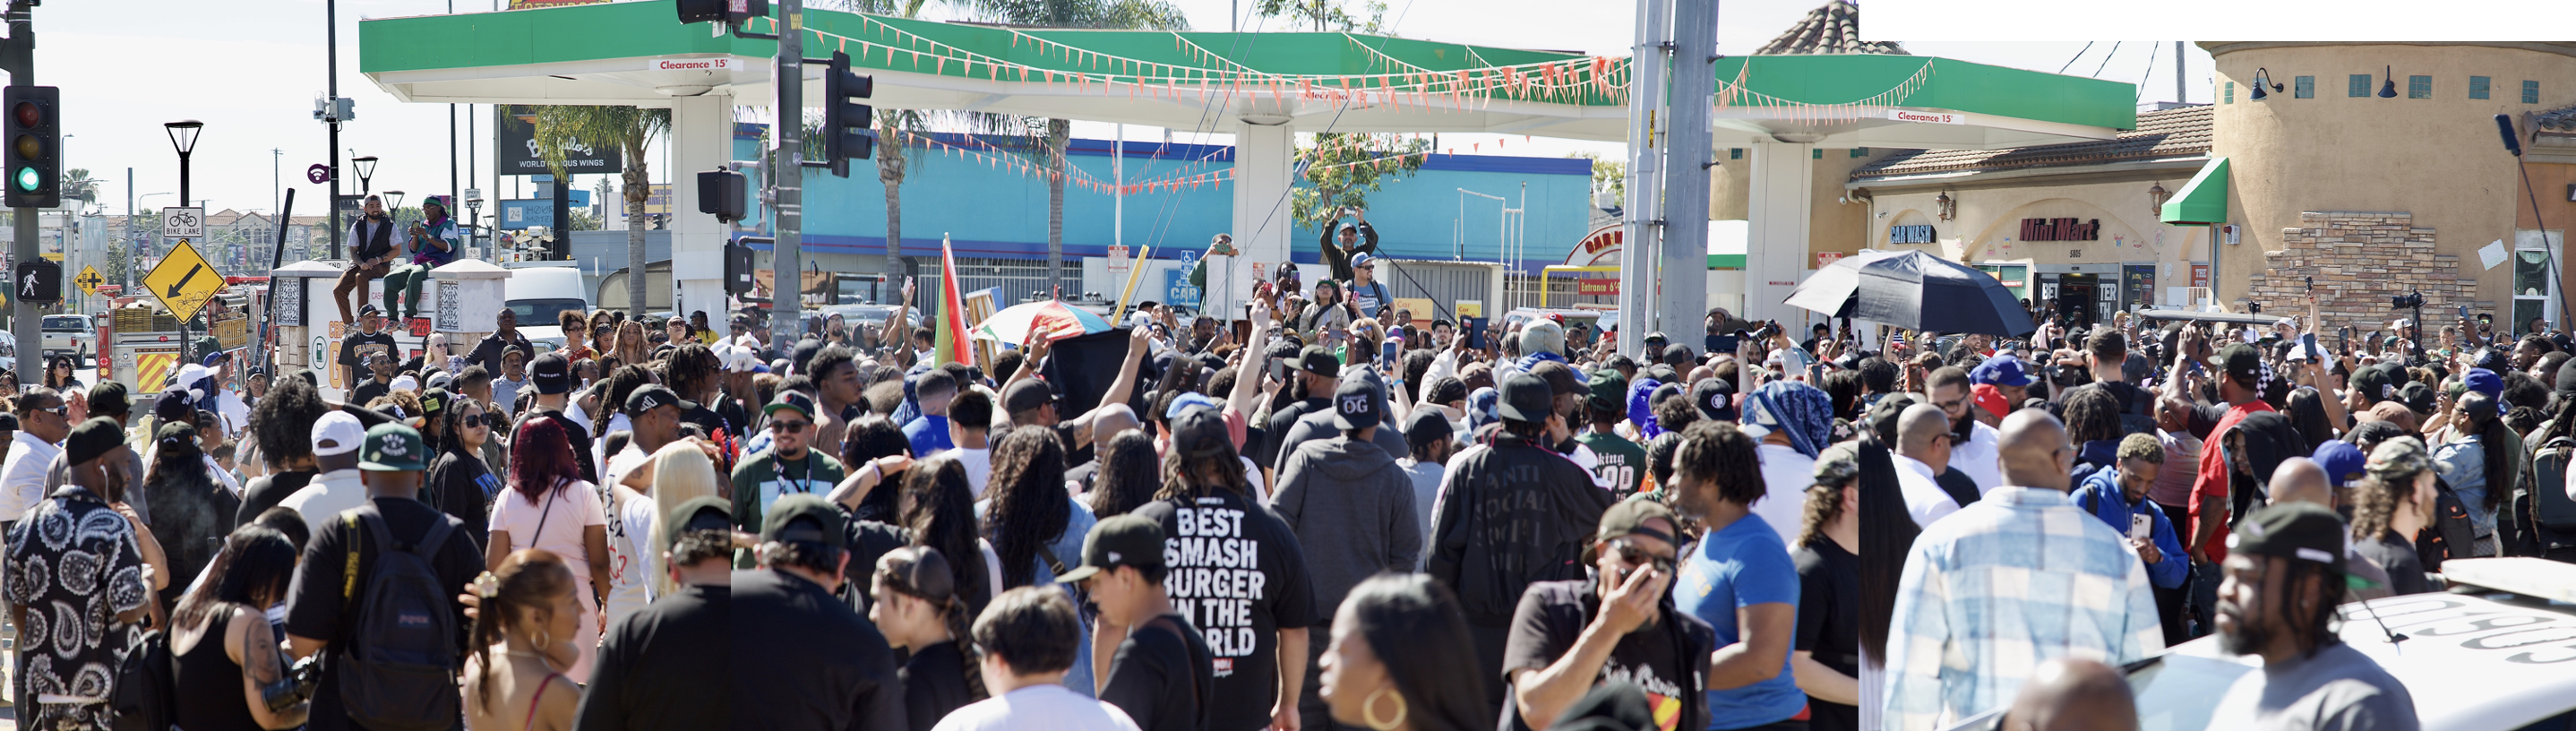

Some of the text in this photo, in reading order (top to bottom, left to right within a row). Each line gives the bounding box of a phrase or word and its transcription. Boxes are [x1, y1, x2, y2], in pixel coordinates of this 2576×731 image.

[660, 58, 728, 70] Clearance 15'
[1898, 111, 1953, 123] Clearance 15'
[510, 210, 520, 219] 24
[1890, 225, 1932, 245] CAR WASH
[2019, 218, 2053, 242] Mini
[2056, 218, 2098, 241] Mart
[1584, 232, 1612, 254] CAR
[2069, 249, 2082, 259] 5805
[2194, 268, 2207, 279] THE
[1170, 287, 1198, 300] CAR
[1581, 280, 1607, 293] Entrance
[2042, 282, 2117, 301] BET TER
[1396, 300, 1412, 308] Car
[1343, 400, 1369, 414] OG
[1486, 464, 1541, 489] ANTI
[1176, 507, 1245, 538] BEST
[1163, 537, 1258, 570] SMASH
[1202, 598, 1252, 627] THE
[1198, 627, 1257, 657] RLD
